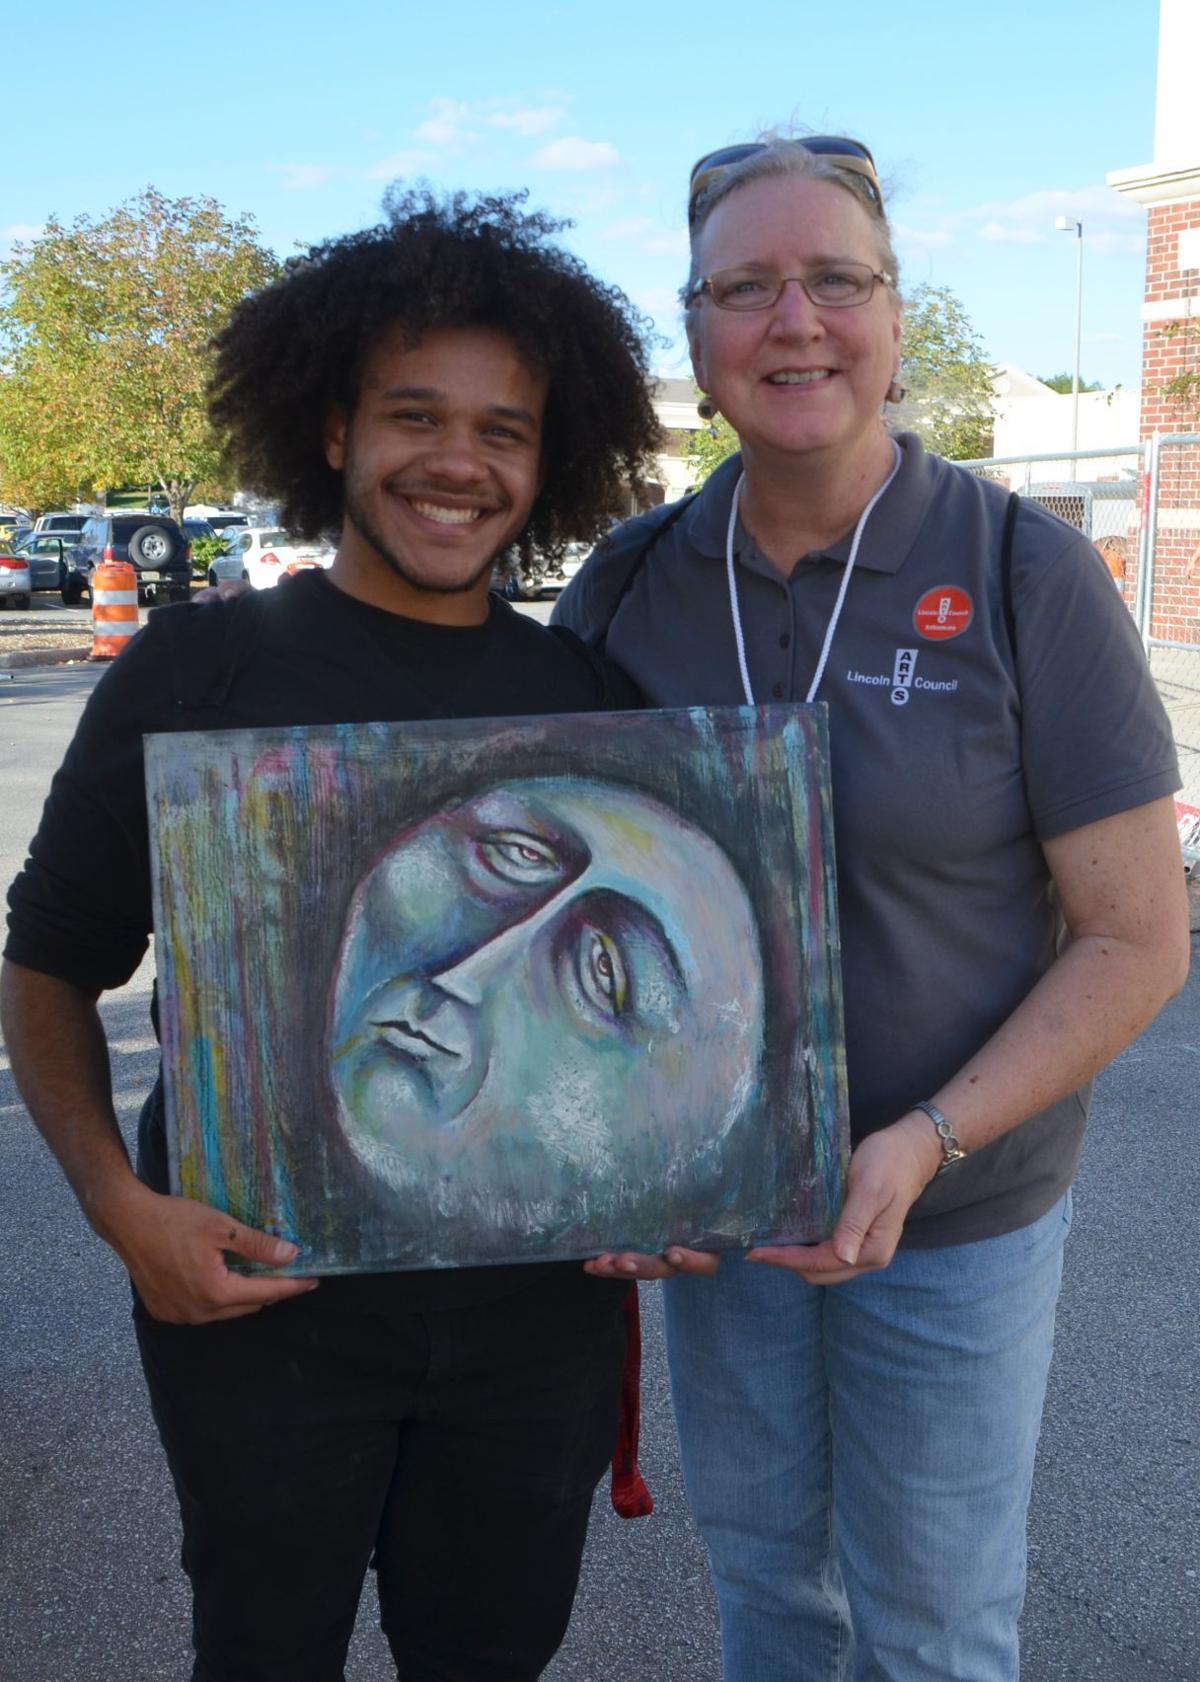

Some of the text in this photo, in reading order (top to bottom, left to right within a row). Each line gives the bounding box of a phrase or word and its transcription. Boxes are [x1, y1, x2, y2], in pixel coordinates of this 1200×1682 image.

[847, 652, 958, 701] Lincoln ARTS Council
